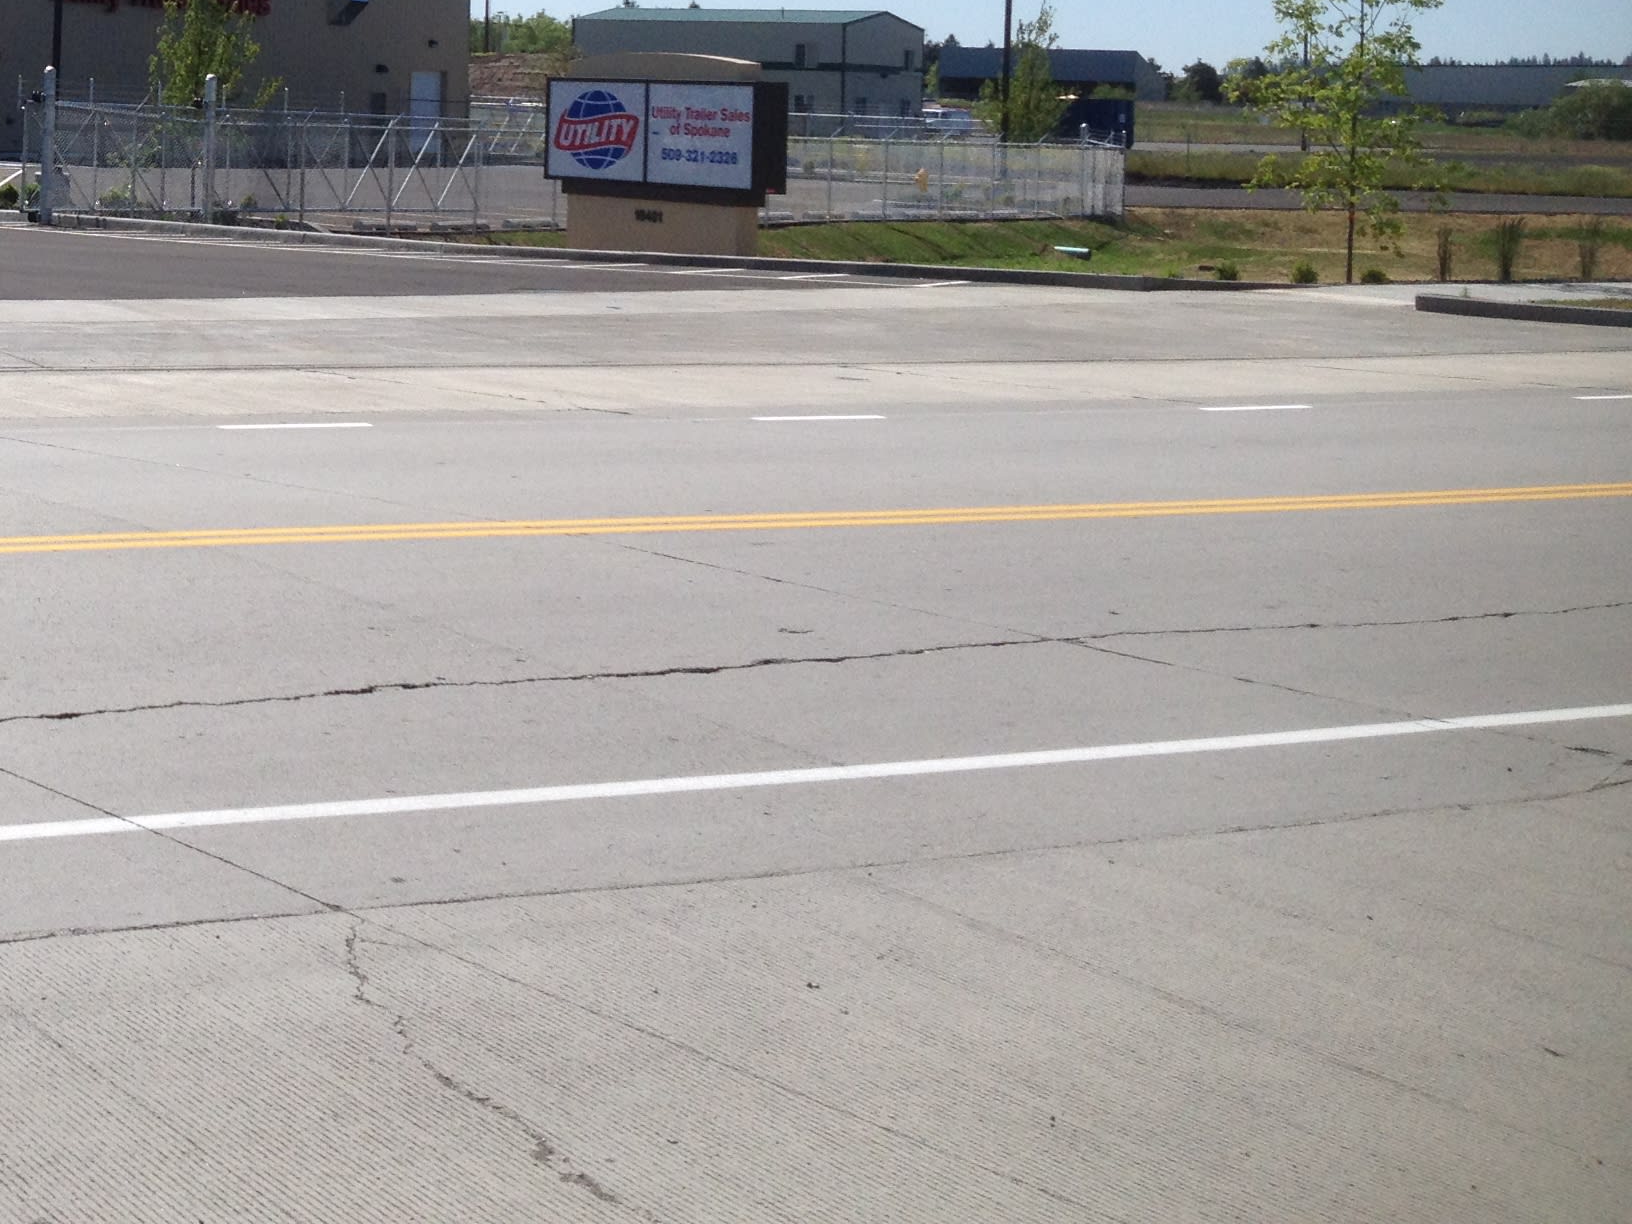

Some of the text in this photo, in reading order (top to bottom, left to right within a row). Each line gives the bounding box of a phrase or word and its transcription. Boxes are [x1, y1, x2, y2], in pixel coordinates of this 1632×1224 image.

[651, 105, 751, 122] Utility Trailer Sales
[559, 118, 634, 147] UTILITY
[669, 122, 730, 139] of Spokane
